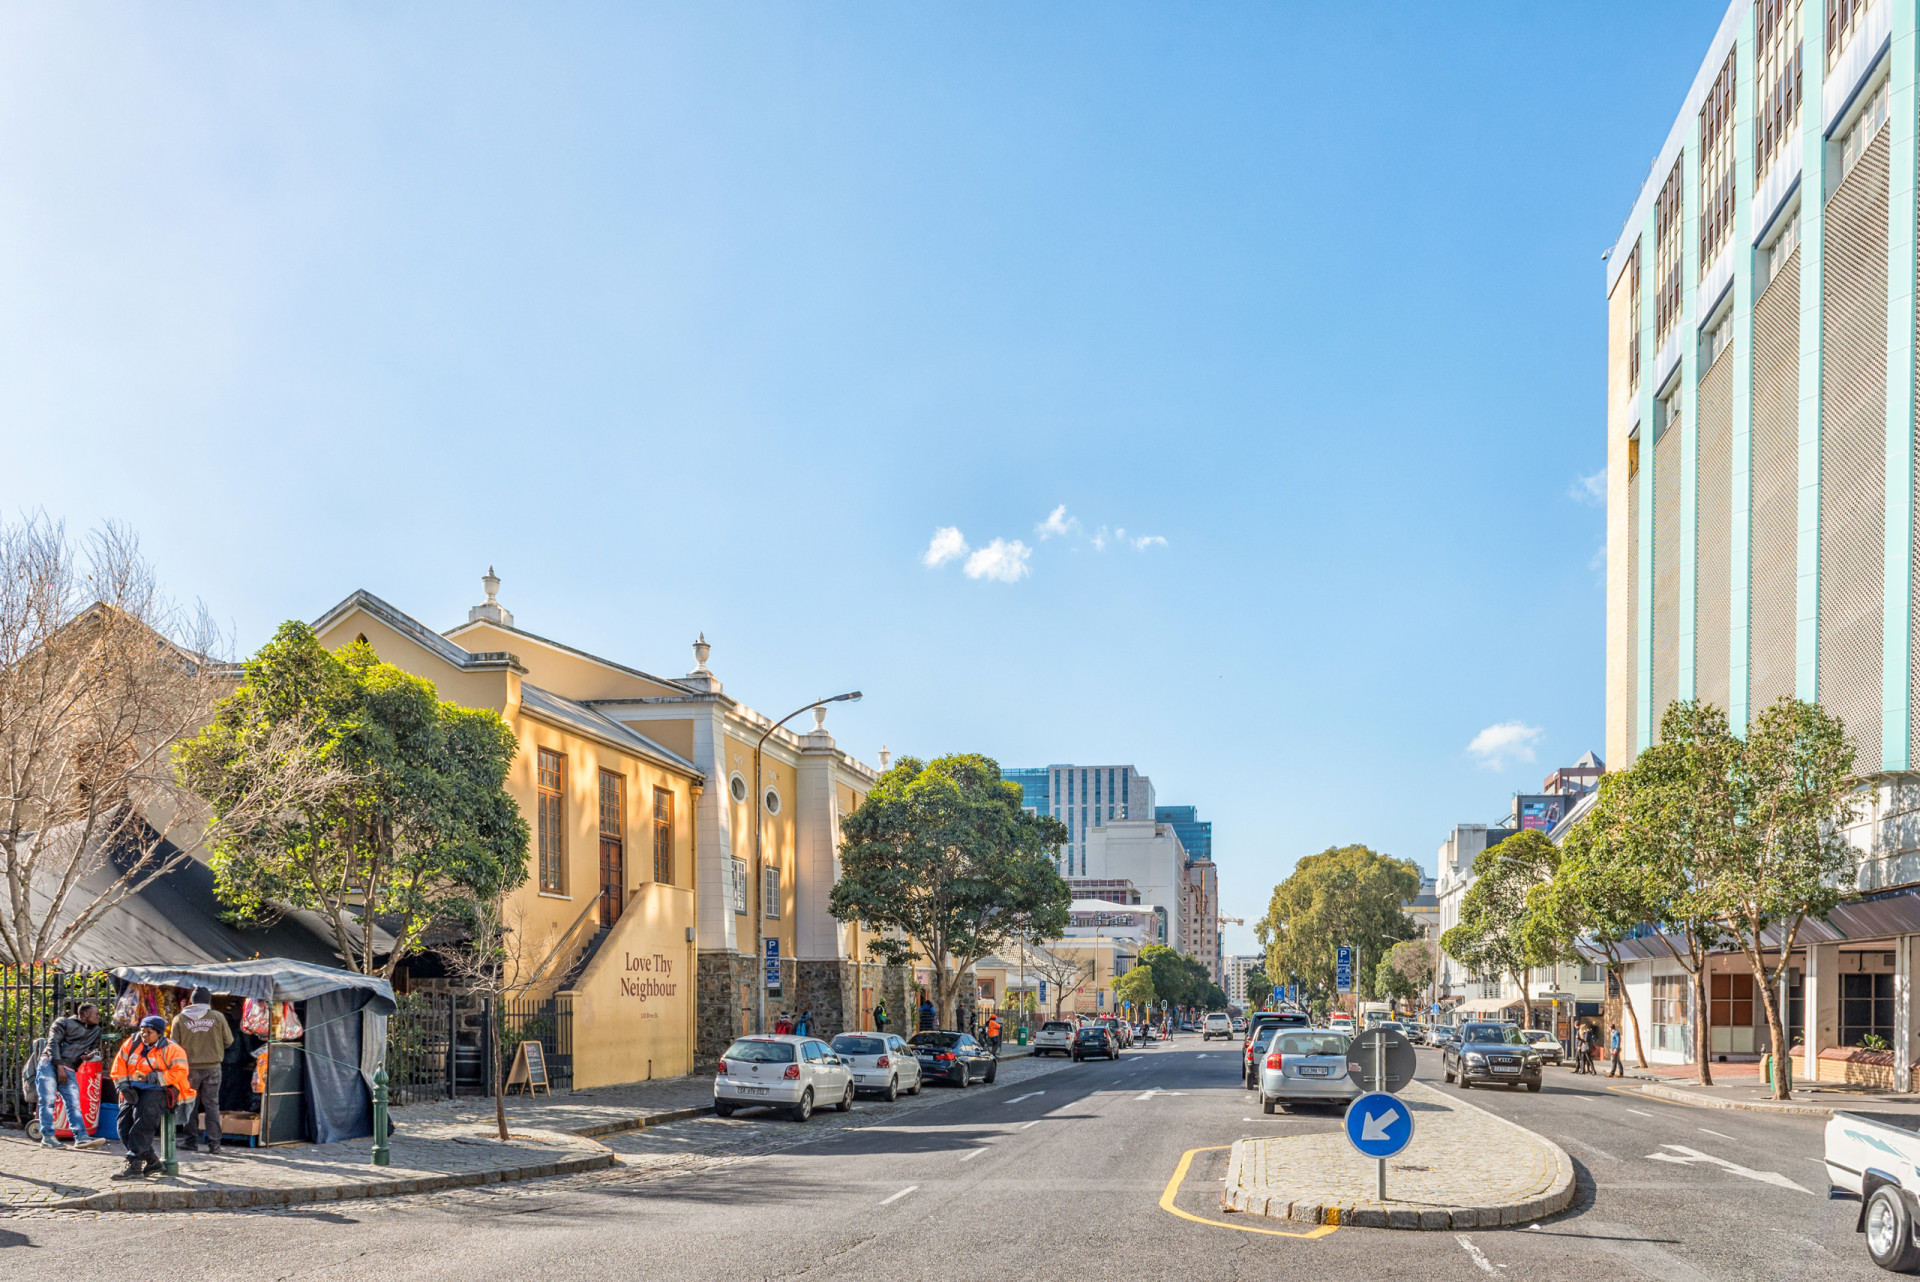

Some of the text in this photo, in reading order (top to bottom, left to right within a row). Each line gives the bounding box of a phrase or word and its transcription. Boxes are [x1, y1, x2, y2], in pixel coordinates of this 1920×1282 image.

[769, 941, 776, 949] P
[1340, 950, 1347, 958] P
[625, 952, 673, 978] Love Thy
[620, 976, 677, 1003] Neighbour
